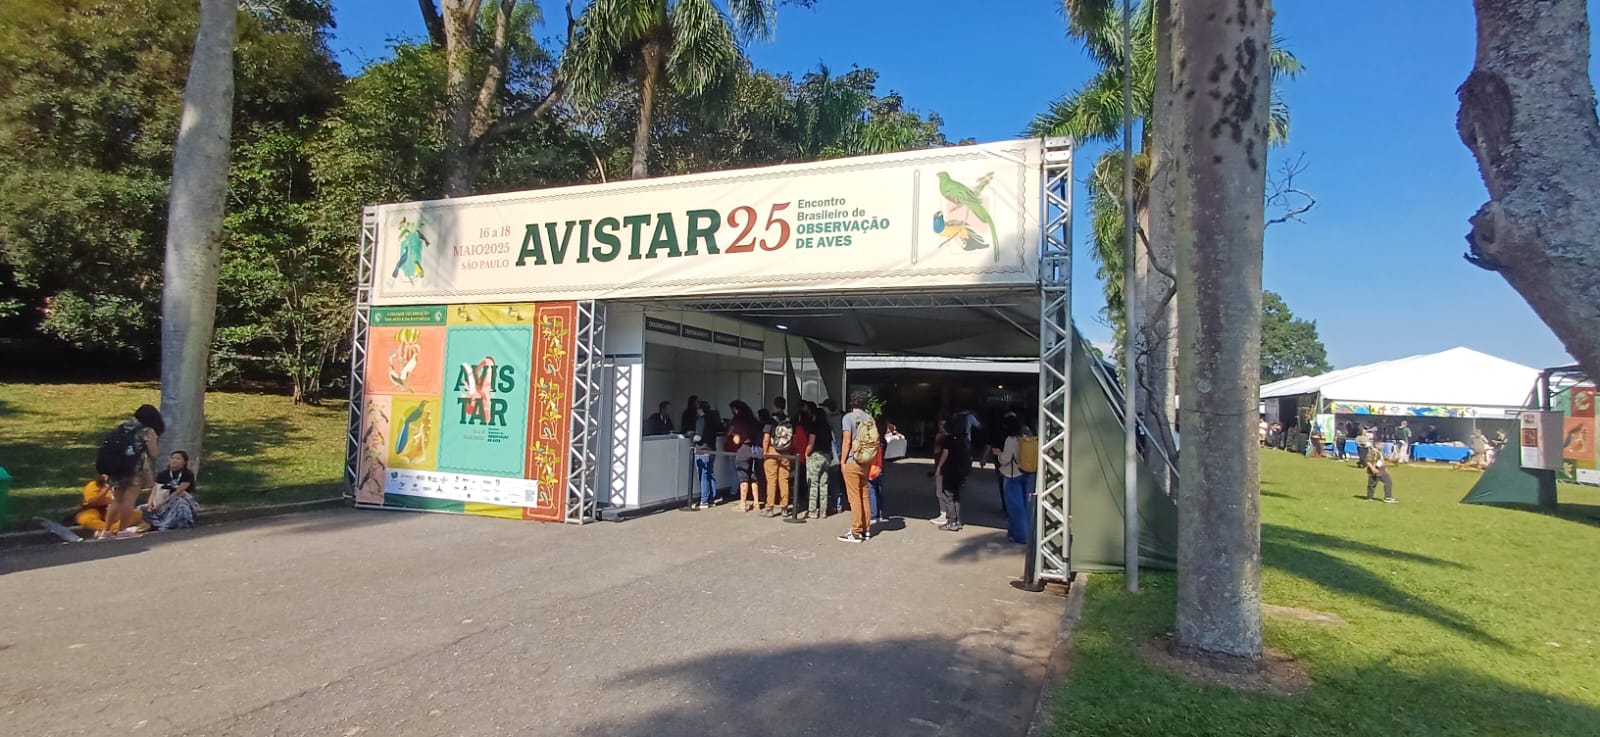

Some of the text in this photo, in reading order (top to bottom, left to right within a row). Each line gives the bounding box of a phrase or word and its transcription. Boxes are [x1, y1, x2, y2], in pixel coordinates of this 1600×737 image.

[797, 197, 846, 209] Encontro
[796, 208, 866, 222] Brasileiro de
[479, 225, 511, 239] 16 a 18
[796, 216, 890, 235] OBSERVAÇÃO
[795, 235, 852, 249] DE AVES
[461, 259, 509, 271] SÃO PAULO
[453, 364, 515, 393] AVIS
[457, 397, 508, 427] TAR
